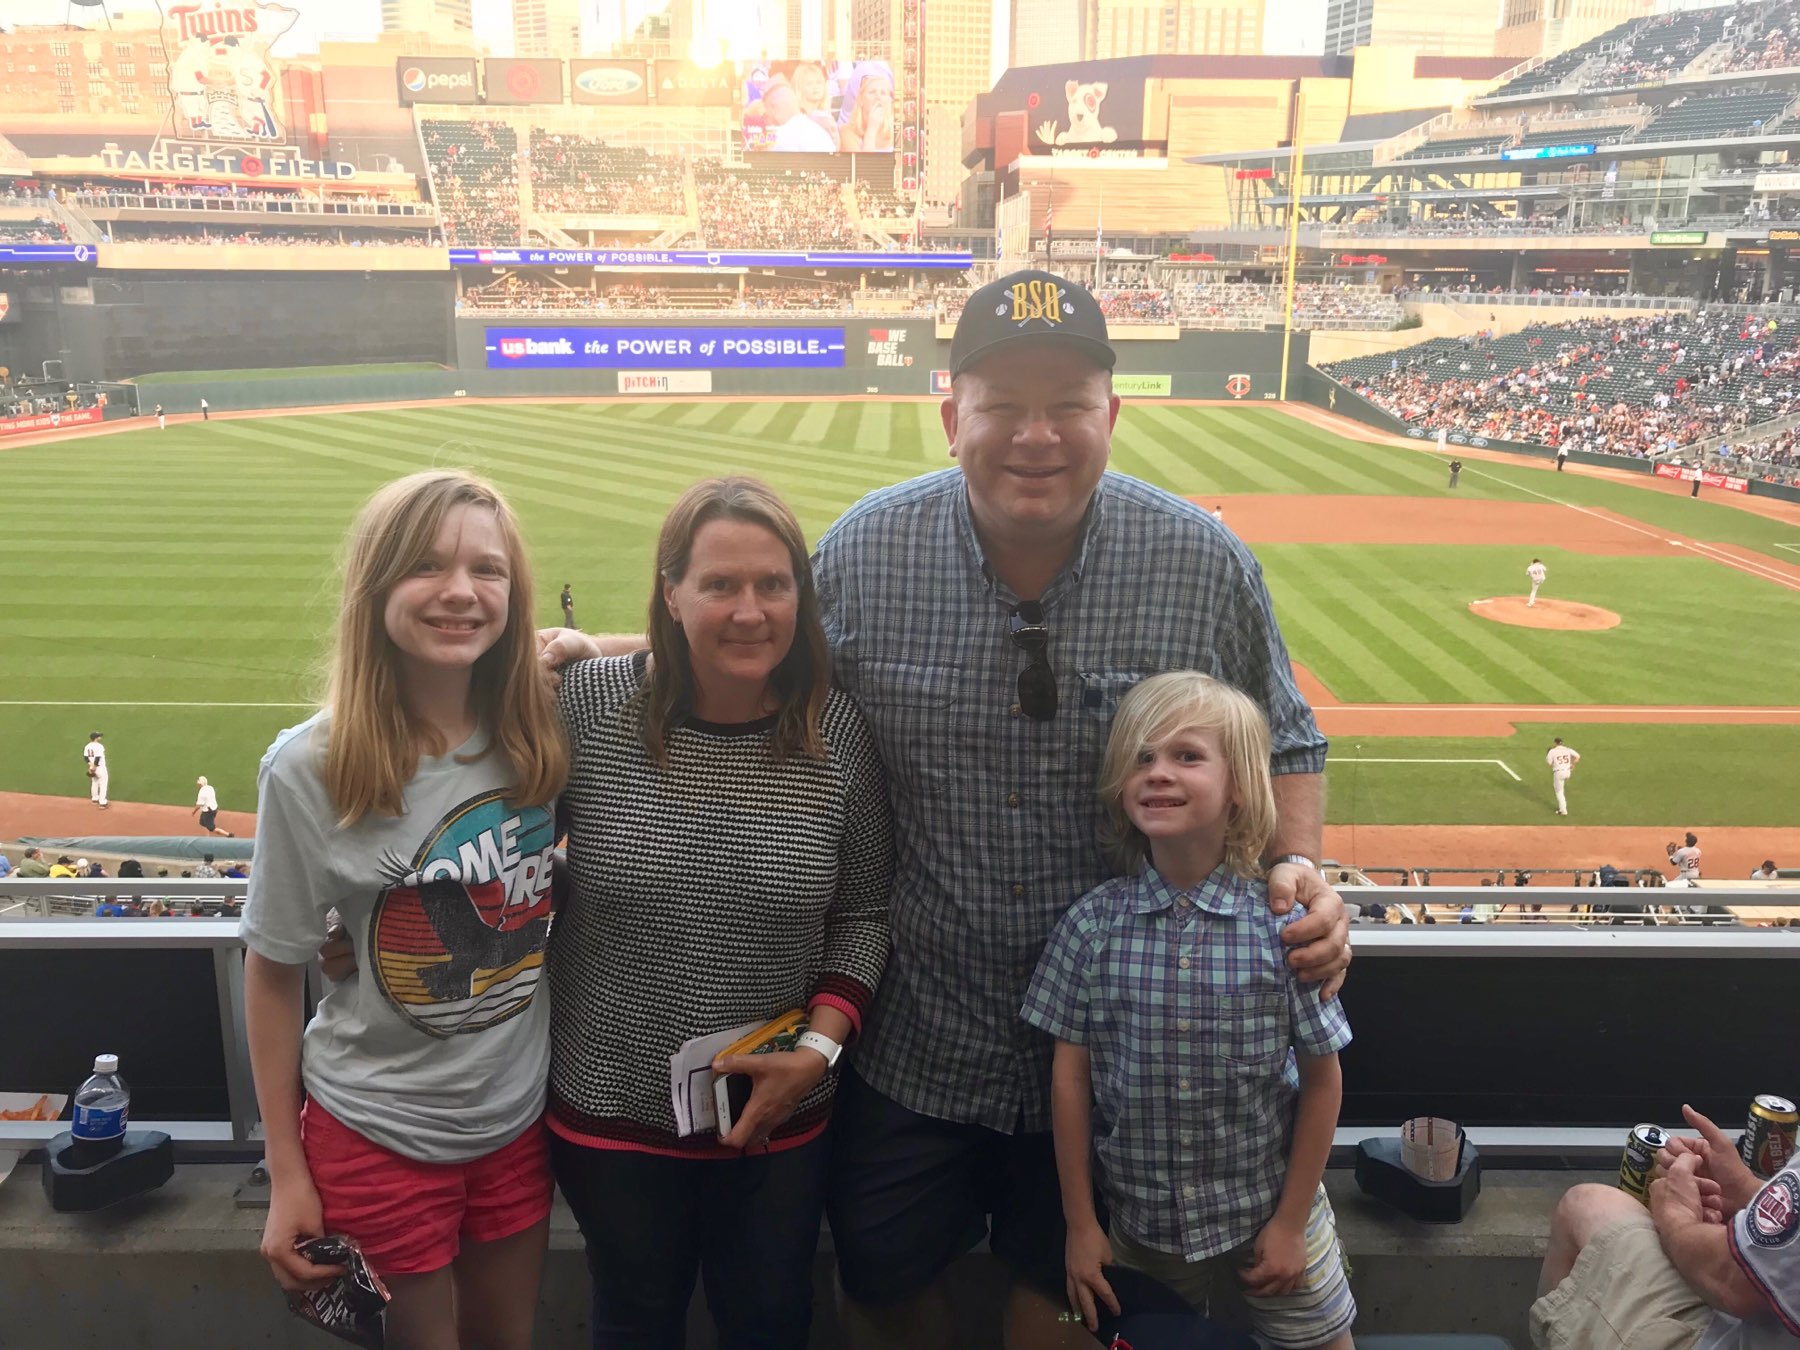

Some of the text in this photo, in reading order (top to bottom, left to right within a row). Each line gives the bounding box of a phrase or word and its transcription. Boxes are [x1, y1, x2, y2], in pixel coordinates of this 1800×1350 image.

[168, 2, 257, 41] Twins
[428, 72, 473, 89] pepsi
[101, 150, 356, 179] TARGET FIELD
[530, 252, 545, 261] the
[548, 252, 593, 261] POWER
[597, 252, 607, 263] of
[611, 252, 673, 262] POSSIBLE.
[1011, 280, 1062, 322] BSQ
[888, 329, 907, 342] WE
[584, 340, 609, 354] the
[616, 340, 691, 355] POWER
[699, 340, 716, 357] of
[722, 340, 827, 355] POSSIBLE.
[867, 341, 898, 354] BASE
[877, 354, 904, 366] BALL
[1112, 381, 1162, 392] enturyLink
[1556, 755, 1570, 765] 55
[1687, 857, 1700, 869] 28
[1768, 1133, 1783, 1157] BELT
[1757, 1186, 1794, 1230] Twins
